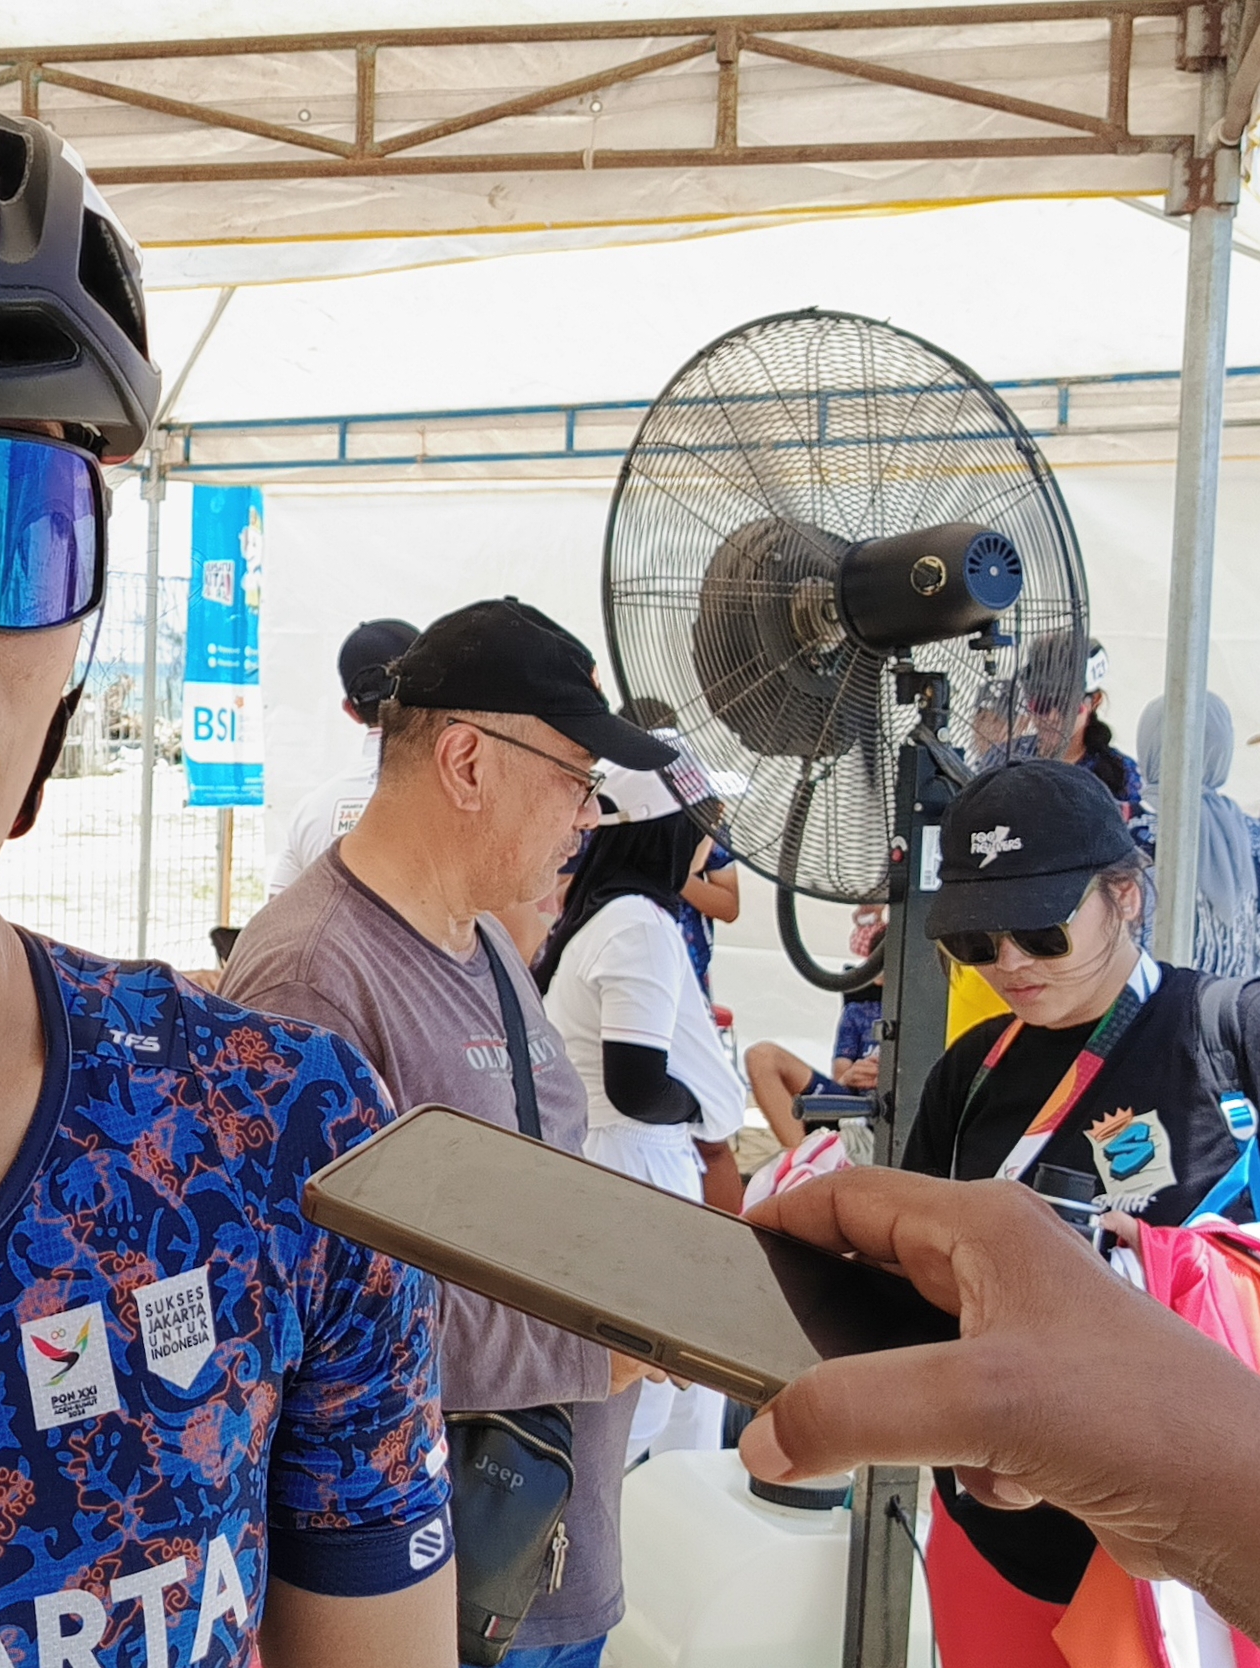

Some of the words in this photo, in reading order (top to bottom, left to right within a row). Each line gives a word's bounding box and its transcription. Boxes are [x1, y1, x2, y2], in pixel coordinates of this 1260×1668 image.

[194, 706, 236, 742] BSI
[144, 1285, 204, 1318] SUKSES
[148, 1302, 207, 1334] JAKARTA
[148, 1317, 208, 1347] UNTUK
[151, 1331, 210, 1360] INDONESIA
[51, 1391, 76, 1406] PON
[77, 1384, 98, 1399] XXI
[475, 1455, 524, 1488] Jeep
